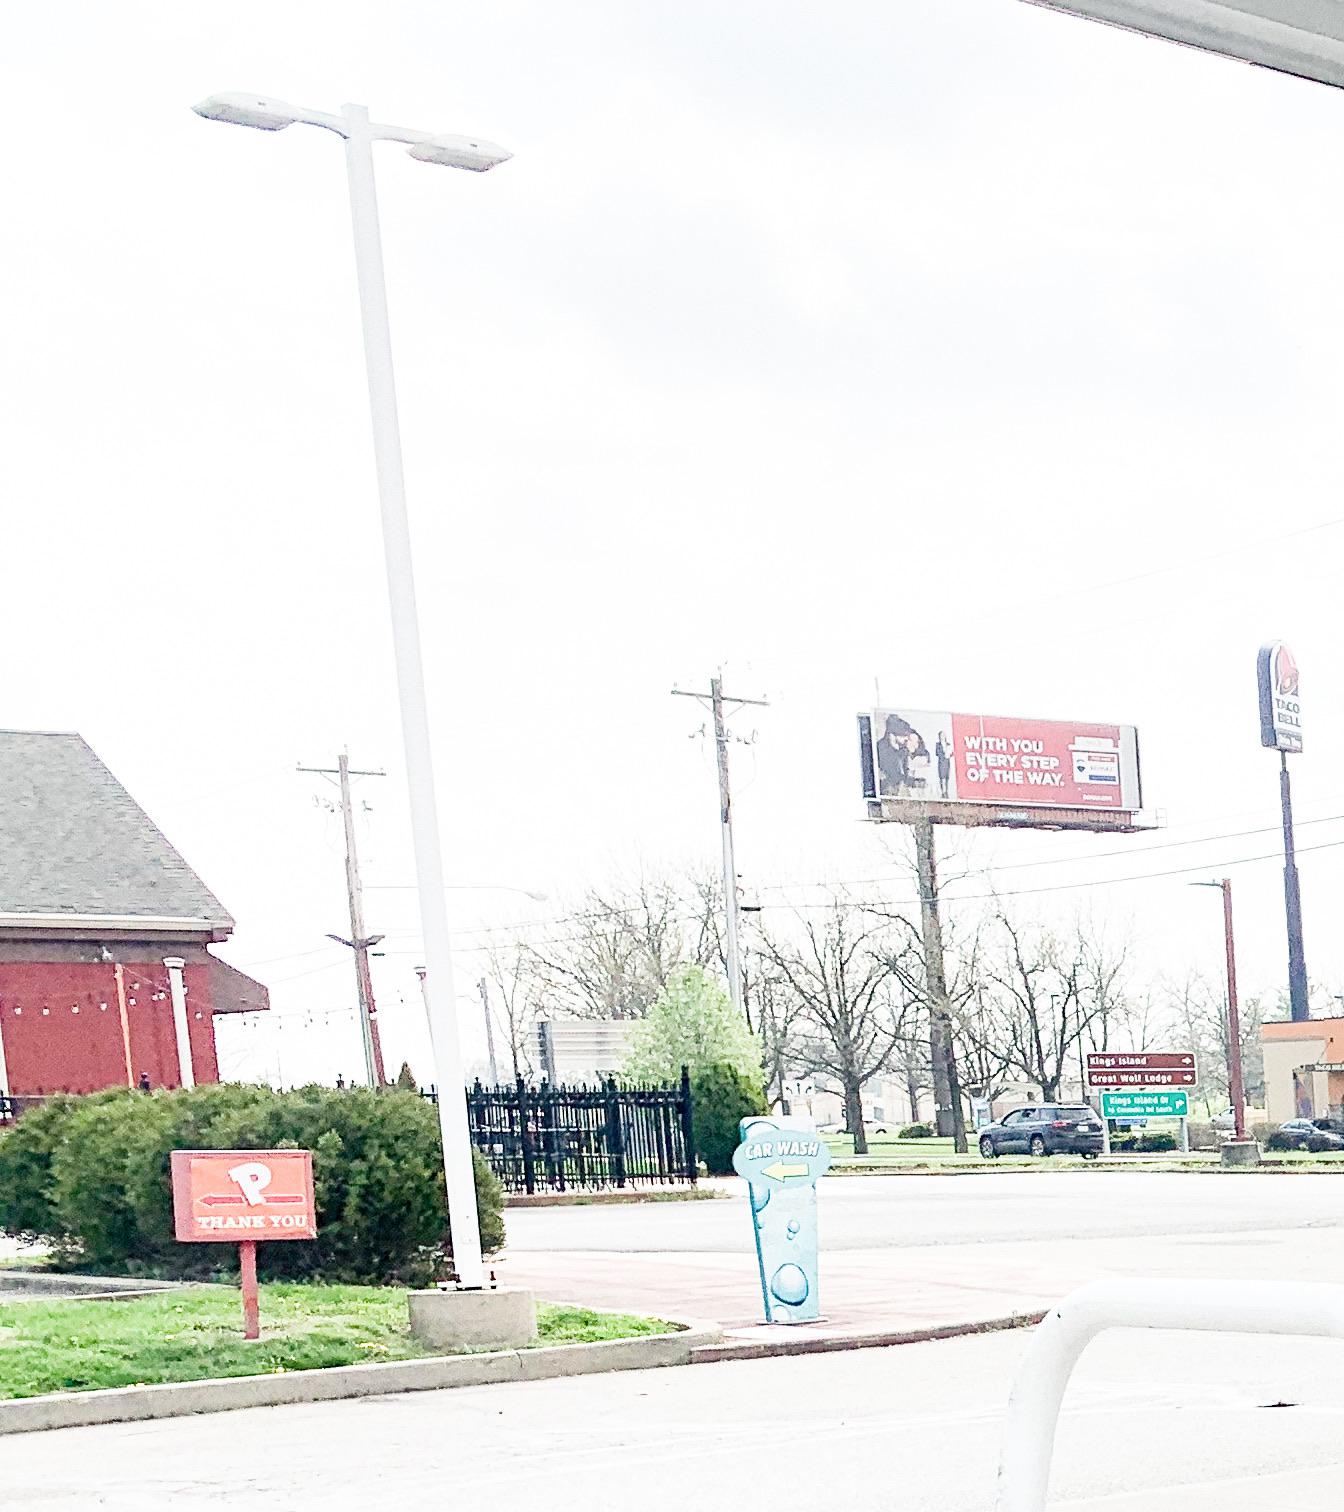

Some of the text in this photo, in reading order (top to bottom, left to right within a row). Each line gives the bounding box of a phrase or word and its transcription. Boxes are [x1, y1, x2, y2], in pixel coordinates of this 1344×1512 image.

[1275, 698, 1300, 713] TACO
[1278, 712, 1301, 727] BELL
[964, 736, 1044, 753] WITH YOU
[966, 752, 1060, 770] EVERY STEP
[966, 768, 1065, 787] OF THE WAY.
[1089, 1056, 1147, 1067] Kings Island
[1091, 1075, 1118, 1084] Great
[1145, 1074, 1173, 1084] Lodge
[1109, 1097, 1131, 1106] Kings
[1134, 1096, 1158, 1104] Island
[745, 1141, 820, 1160] CAR WASH
[196, 1215, 307, 1229] THANK YOU
